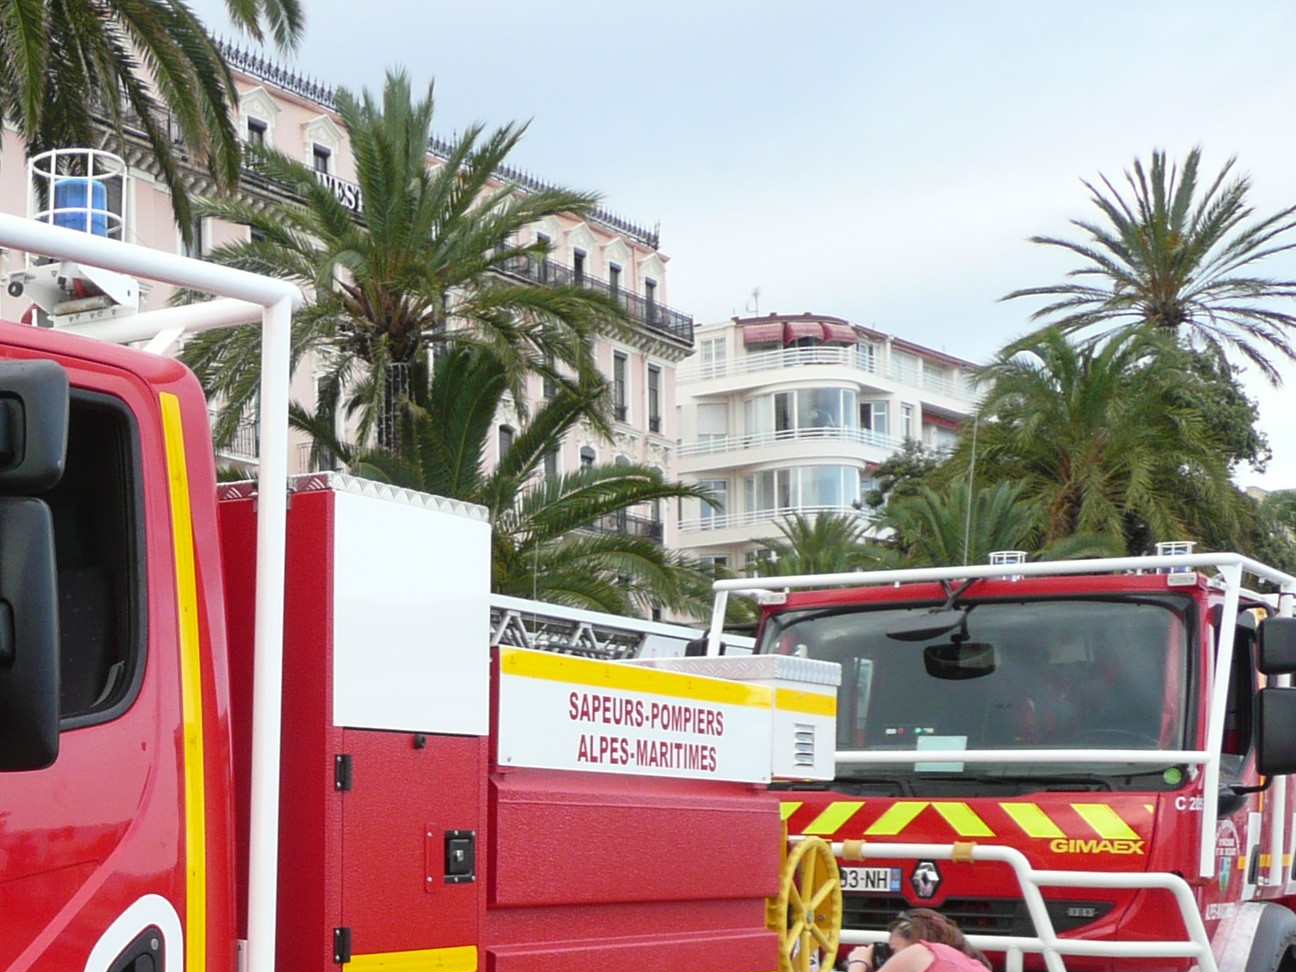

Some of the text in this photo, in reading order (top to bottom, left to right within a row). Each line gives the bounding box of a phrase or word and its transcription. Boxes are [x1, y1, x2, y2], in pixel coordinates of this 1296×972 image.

[569, 691, 724, 737] SAPEURS-POMPIERS
[577, 734, 717, 772] ALPES-MARITIMES
[1175, 796, 1186, 810] C
[1050, 839, 1144, 855] GIMAEX
